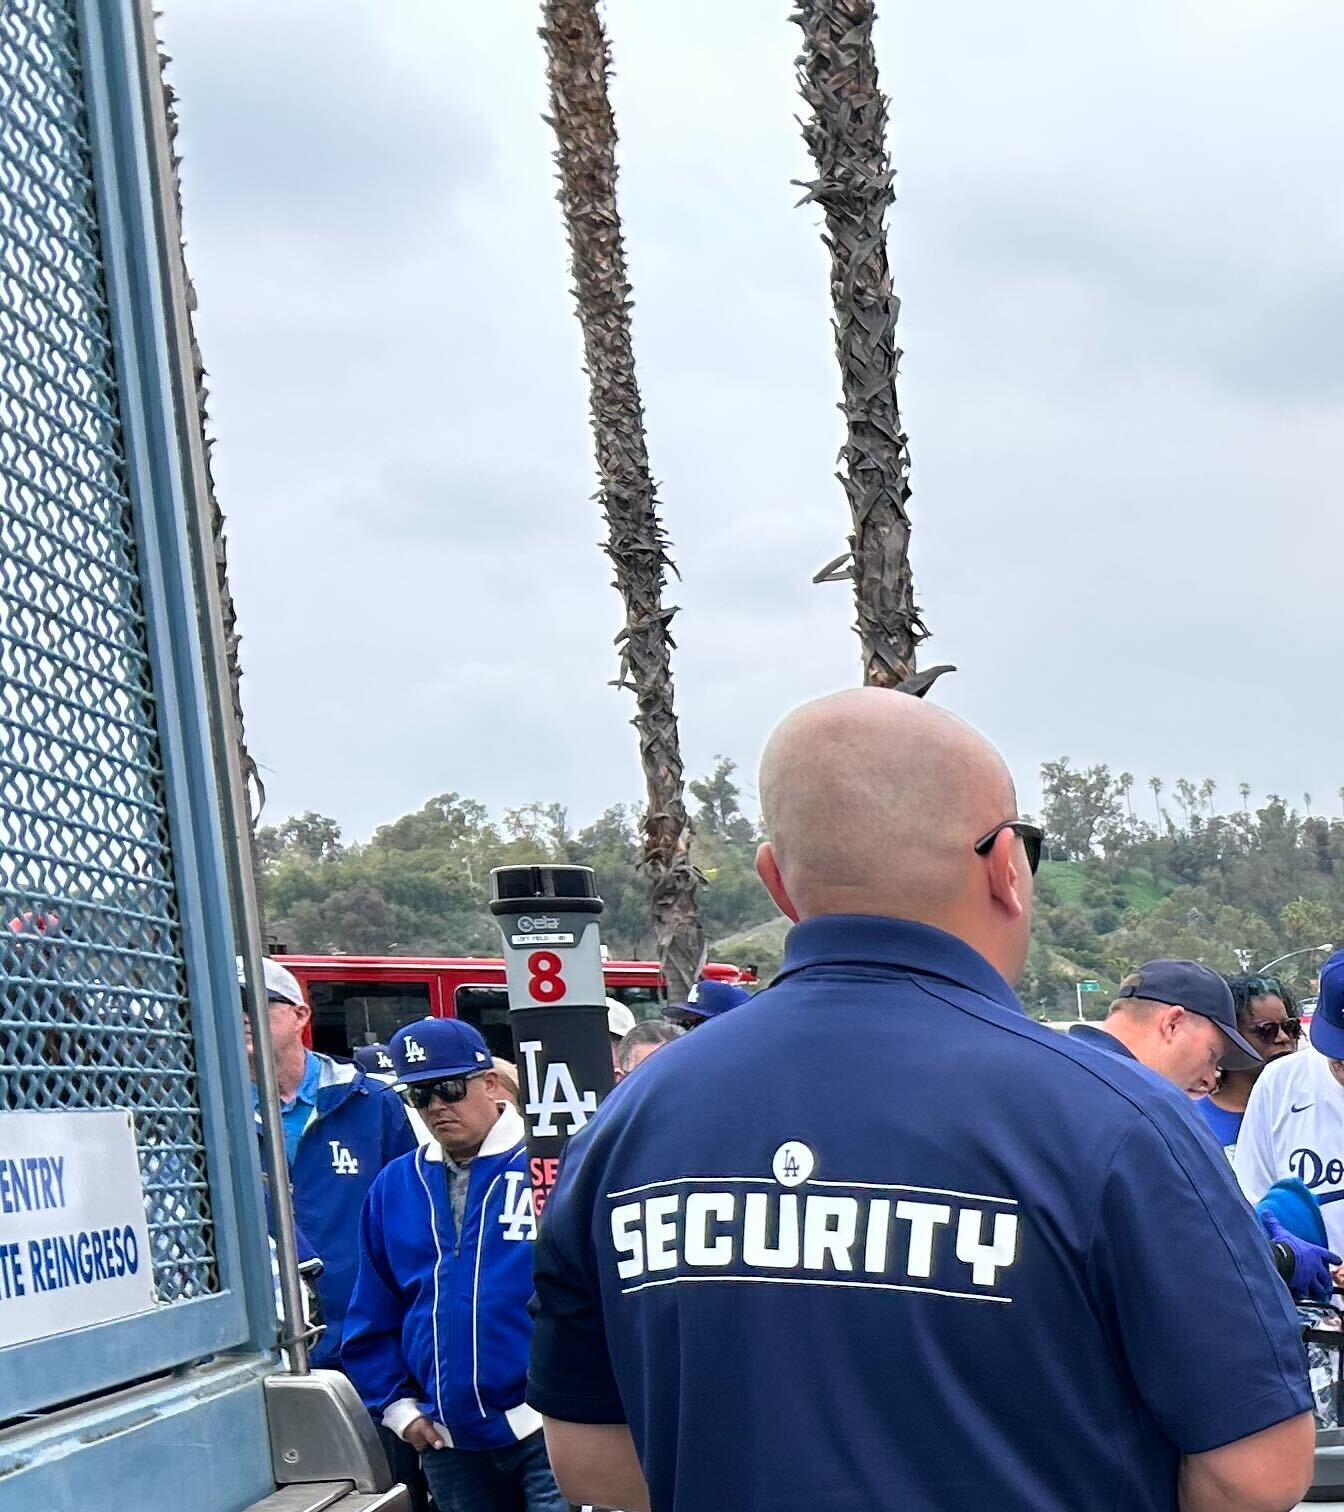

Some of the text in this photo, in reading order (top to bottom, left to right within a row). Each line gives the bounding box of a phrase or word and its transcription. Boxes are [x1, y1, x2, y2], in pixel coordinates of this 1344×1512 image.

[528, 951, 566, 1002] 8
[376, 1051, 394, 1068] LA
[404, 1036, 427, 1062] LA
[519, 1040, 598, 1137] LA
[329, 1141, 359, 1174] LA
[783, 1149, 800, 1177] LA
[498, 1171, 538, 1241] LA
[28, 1225, 138, 1292] REINGRESO
[610, 1193, 1018, 1286] SECURITY
